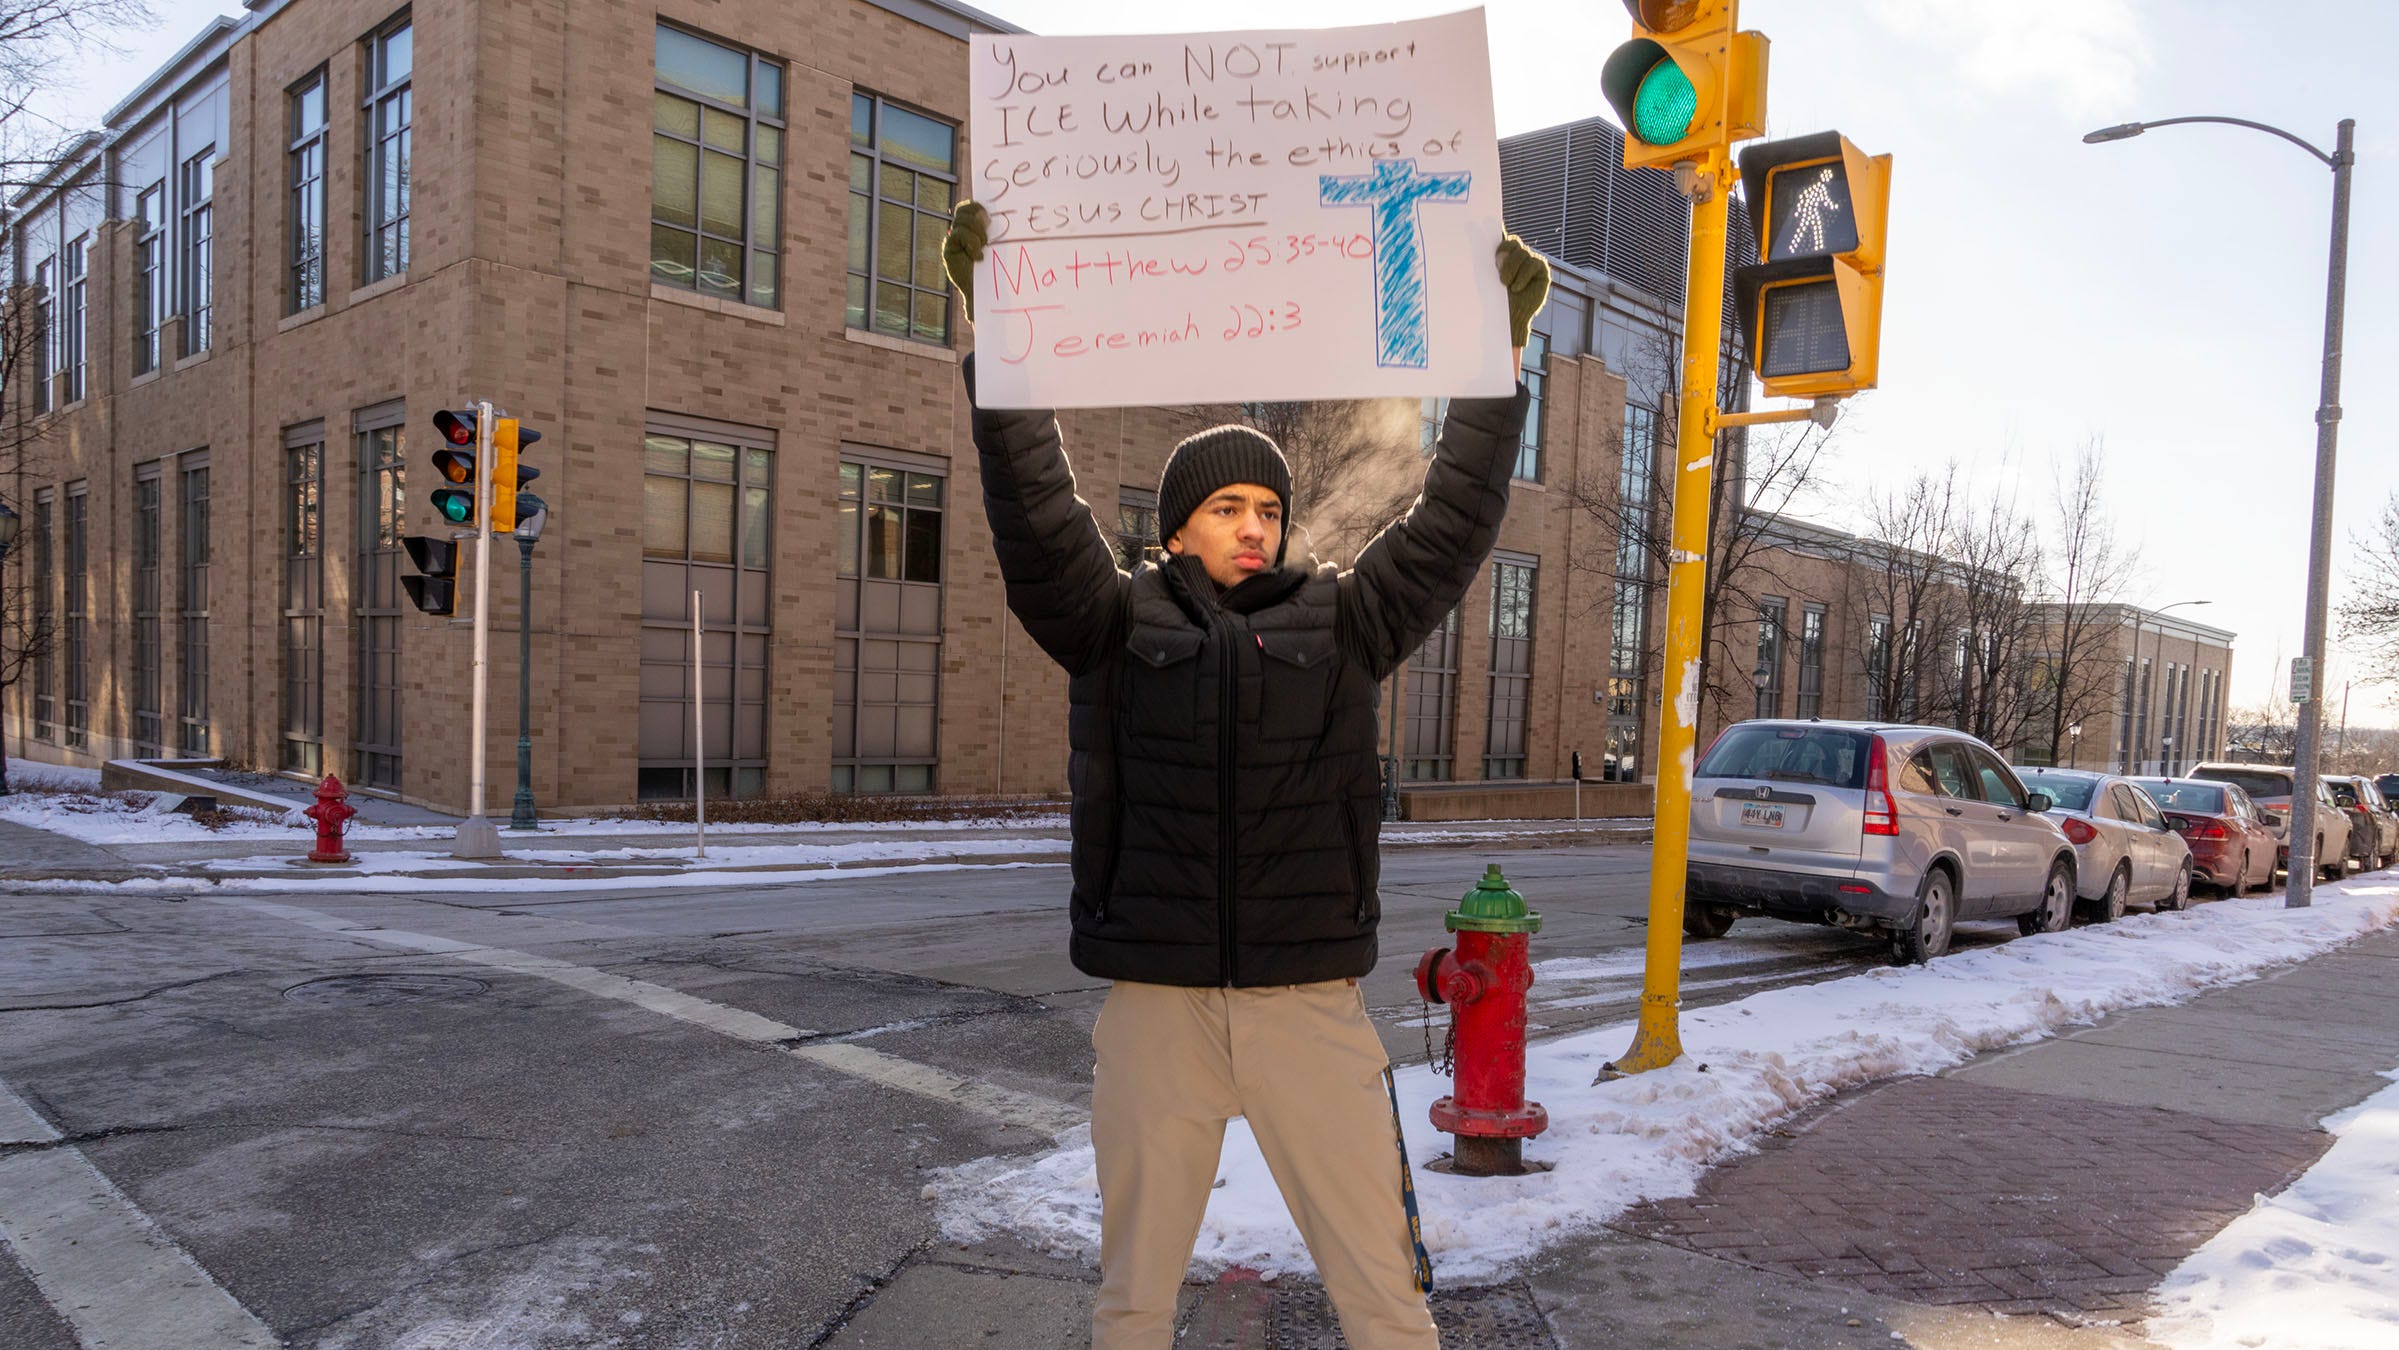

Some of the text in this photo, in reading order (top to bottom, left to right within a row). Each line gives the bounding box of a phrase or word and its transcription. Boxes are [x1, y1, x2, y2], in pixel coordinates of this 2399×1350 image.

[1096, 61, 1152, 85] can
[1184, 42, 1297, 87] NOT
[1312, 40, 1416, 76] support
[992, 103, 1079, 149] ICE
[1236, 84, 1413, 139] taking
[1204, 136, 1271, 169] the
[1287, 137, 1402, 166] ethics
[1421, 129, 1463, 156] of
[988, 192, 1269, 243] JESUS CHRIST
[989, 235, 1375, 301] Matthew 25:35-40
[989, 301, 1302, 365] Jeremiah 22:3
